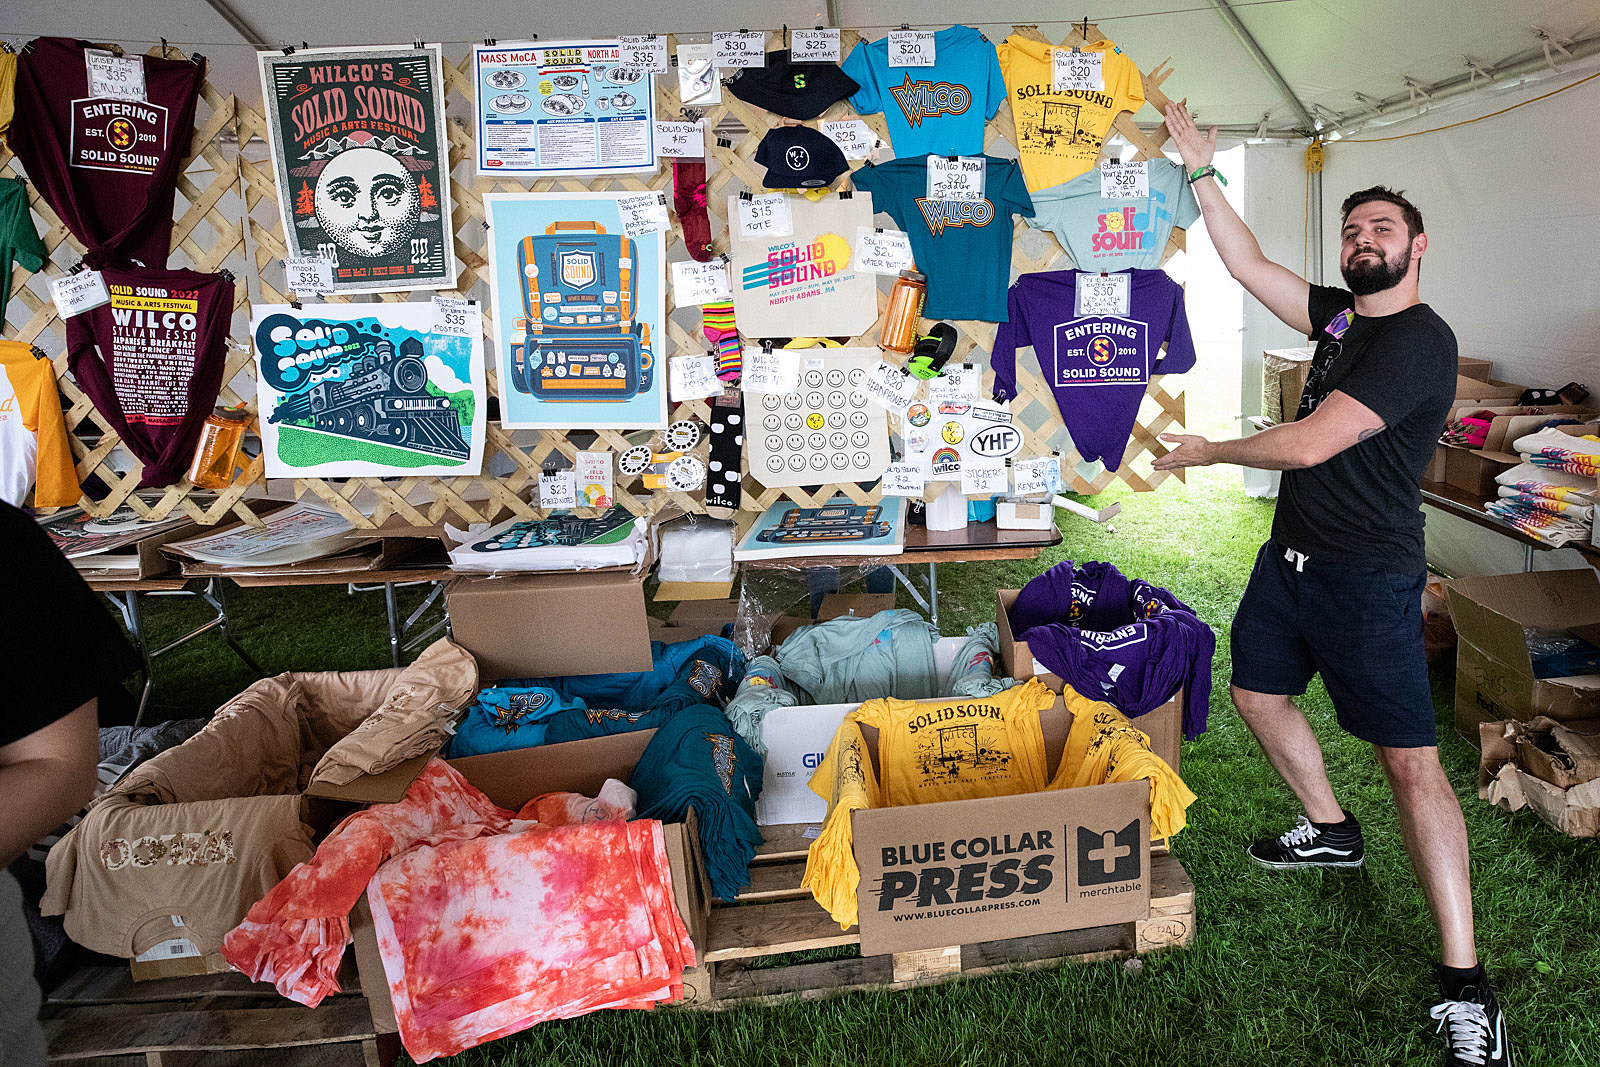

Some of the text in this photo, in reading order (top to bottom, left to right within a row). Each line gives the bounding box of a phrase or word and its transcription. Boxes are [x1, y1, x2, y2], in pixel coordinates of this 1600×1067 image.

[725, 41, 746, 52] $30
[805, 40, 826, 50] $25
[900, 44, 921, 54] $20
[480, 52, 538, 64] MASS MoCA
[544, 49, 582, 58] SOLID
[588, 50, 608, 59] NORTH
[633, 52, 654, 62] $35
[544, 57, 582, 66] SOUND
[728, 58, 748, 66] CAPO
[106, 70, 127, 82] $35
[309, 63, 394, 84] WILCO'S
[1070, 66, 1090, 78] $20
[891, 74, 972, 128] WILCO
[1066, 89, 1113, 109] SOUND
[82, 103, 158, 126] ENTERING
[291, 85, 426, 142] SOLID SOUND
[85, 128, 105, 138] EST.
[138, 134, 157, 143] 2010
[303, 120, 420, 150] MUSIC & ARTS FESTIVAL
[672, 135, 687, 144] $15
[835, 131, 856, 142] $25
[80, 150, 160, 166] SOLID SOUND
[946, 174, 967, 184] $20
[1116, 176, 1136, 186] $20
[752, 208, 772, 218] $15
[746, 220, 772, 230] TOTE
[768, 242, 796, 252] WILCO'S
[566, 258, 590, 266] SOLID
[768, 242, 826, 270] SOLID
[564, 263, 592, 279] SOUND
[768, 260, 836, 290] SOUND
[58, 276, 83, 288] BACK
[300, 272, 320, 284] $35
[60, 280, 96, 298] ENTERING
[110, 284, 199, 300] SOLID SOUND 2022
[1094, 286, 1114, 296] $30
[769, 294, 795, 306] NORTH
[824, 286, 836, 294] MA
[144, 300, 160, 308] ARTS
[163, 302, 192, 310] FESTIVAL
[112, 308, 197, 330] WILCO
[445, 314, 466, 326] $35
[112, 326, 196, 341] SYLVAN ESSO
[1064, 322, 1138, 341] ENTERING
[113, 336, 196, 349] JAPANESE BREAKFAST
[270, 326, 350, 358] SOLID
[343, 342, 361, 352] 2022
[114, 344, 136, 352] BONNIE
[176, 348, 196, 356] BILLY
[1067, 348, 1086, 357] EST.
[1118, 348, 1137, 356] 2010
[278, 345, 344, 383] SOUND
[878, 364, 906, 384] KIDS
[1062, 367, 1140, 378] SOLID SOUND
[884, 374, 903, 391] $20
[948, 375, 962, 386] $8
[977, 432, 1014, 452] YHF
[934, 463, 961, 474] wilco
[965, 468, 1005, 479] STICKERS
[550, 484, 567, 494] $25
[974, 480, 991, 490] $2
[706, 496, 733, 506] wilco
[908, 706, 955, 735] SOLID
[942, 729, 975, 742] WILCO
[881, 830, 1055, 868] BLUE COLLAR
[870, 854, 1055, 912] PRESS
[1079, 883, 1142, 899] merchtable
[893, 898, 1041, 922] WWW.BLUECOLLARPRESS.COM
